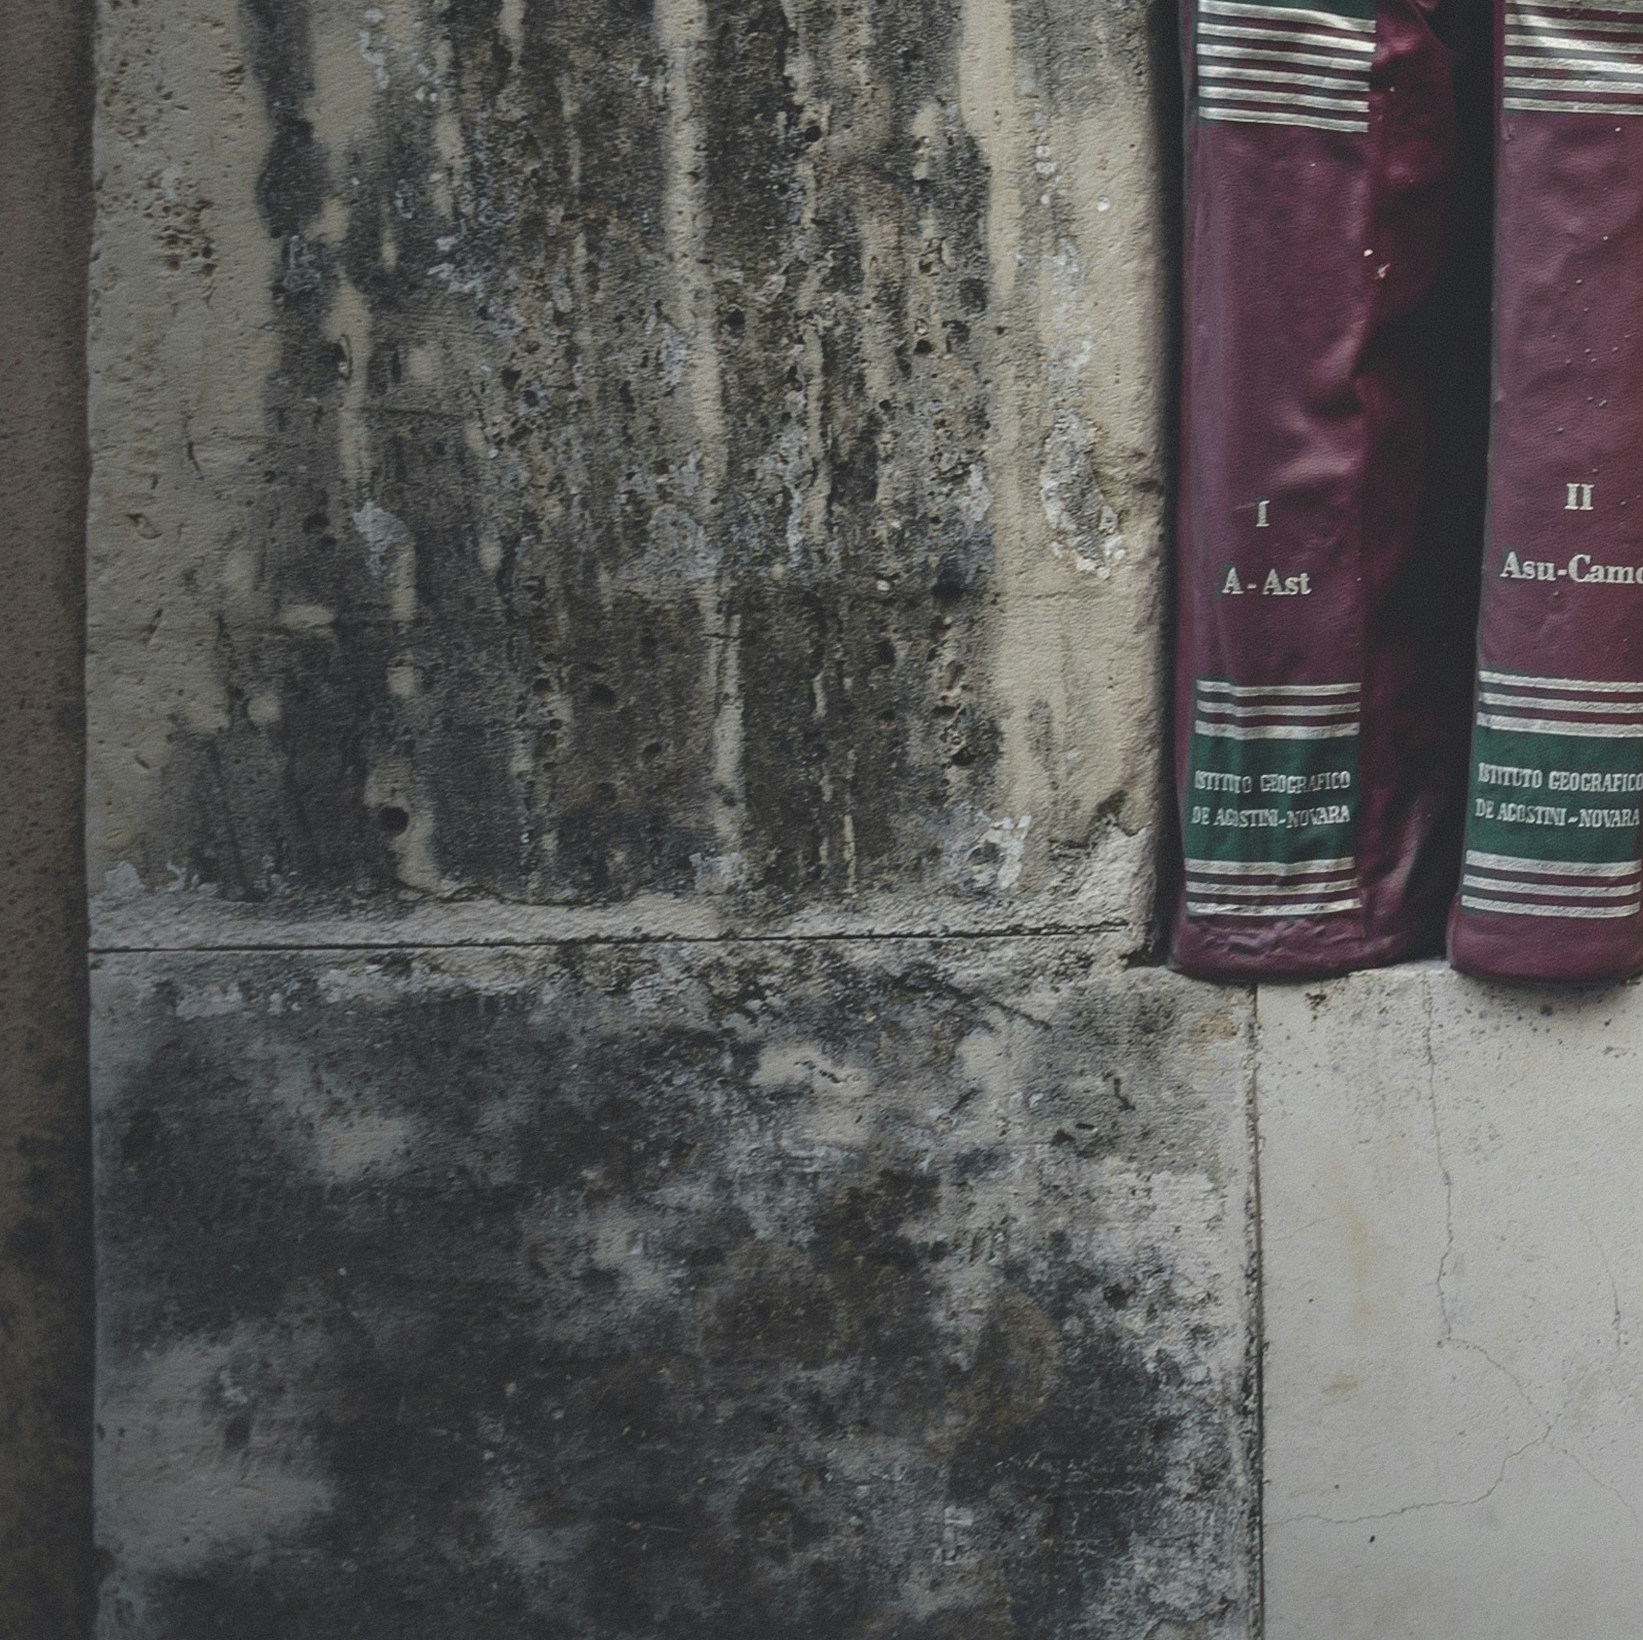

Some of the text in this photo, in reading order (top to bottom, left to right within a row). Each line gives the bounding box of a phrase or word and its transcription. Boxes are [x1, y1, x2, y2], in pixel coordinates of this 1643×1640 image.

[1565, 483, 1594, 511] II
[1255, 499, 1270, 528] I
[1190, 805, 1211, 826] DE
[1474, 798, 1495, 819] DE
